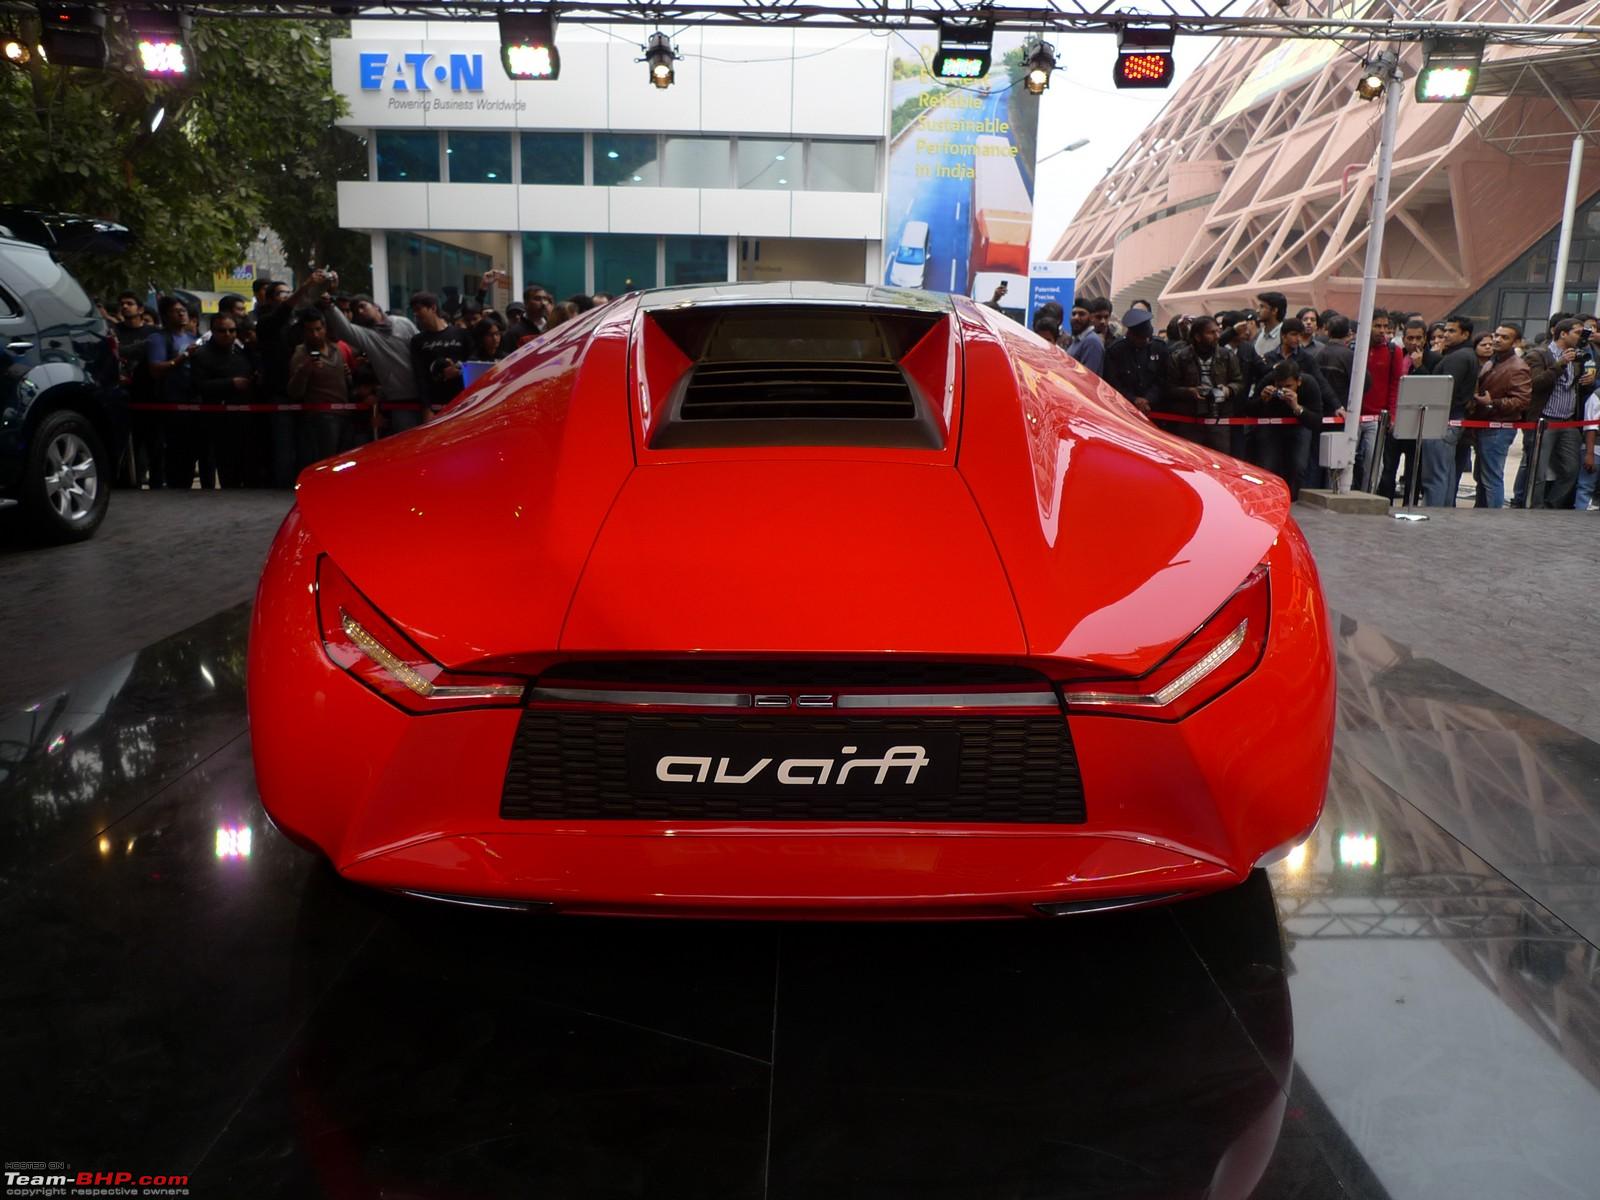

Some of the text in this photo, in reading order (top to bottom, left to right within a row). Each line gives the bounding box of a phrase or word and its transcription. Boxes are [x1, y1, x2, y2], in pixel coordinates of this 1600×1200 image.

[359, 53, 484, 92] EATON
[388, 97, 527, 112] Powering Business Worldwide
[919, 93, 983, 109] Reliable
[917, 117, 1010, 134] Sustainable
[916, 139, 1018, 157] Performance
[915, 163, 976, 179] in India
